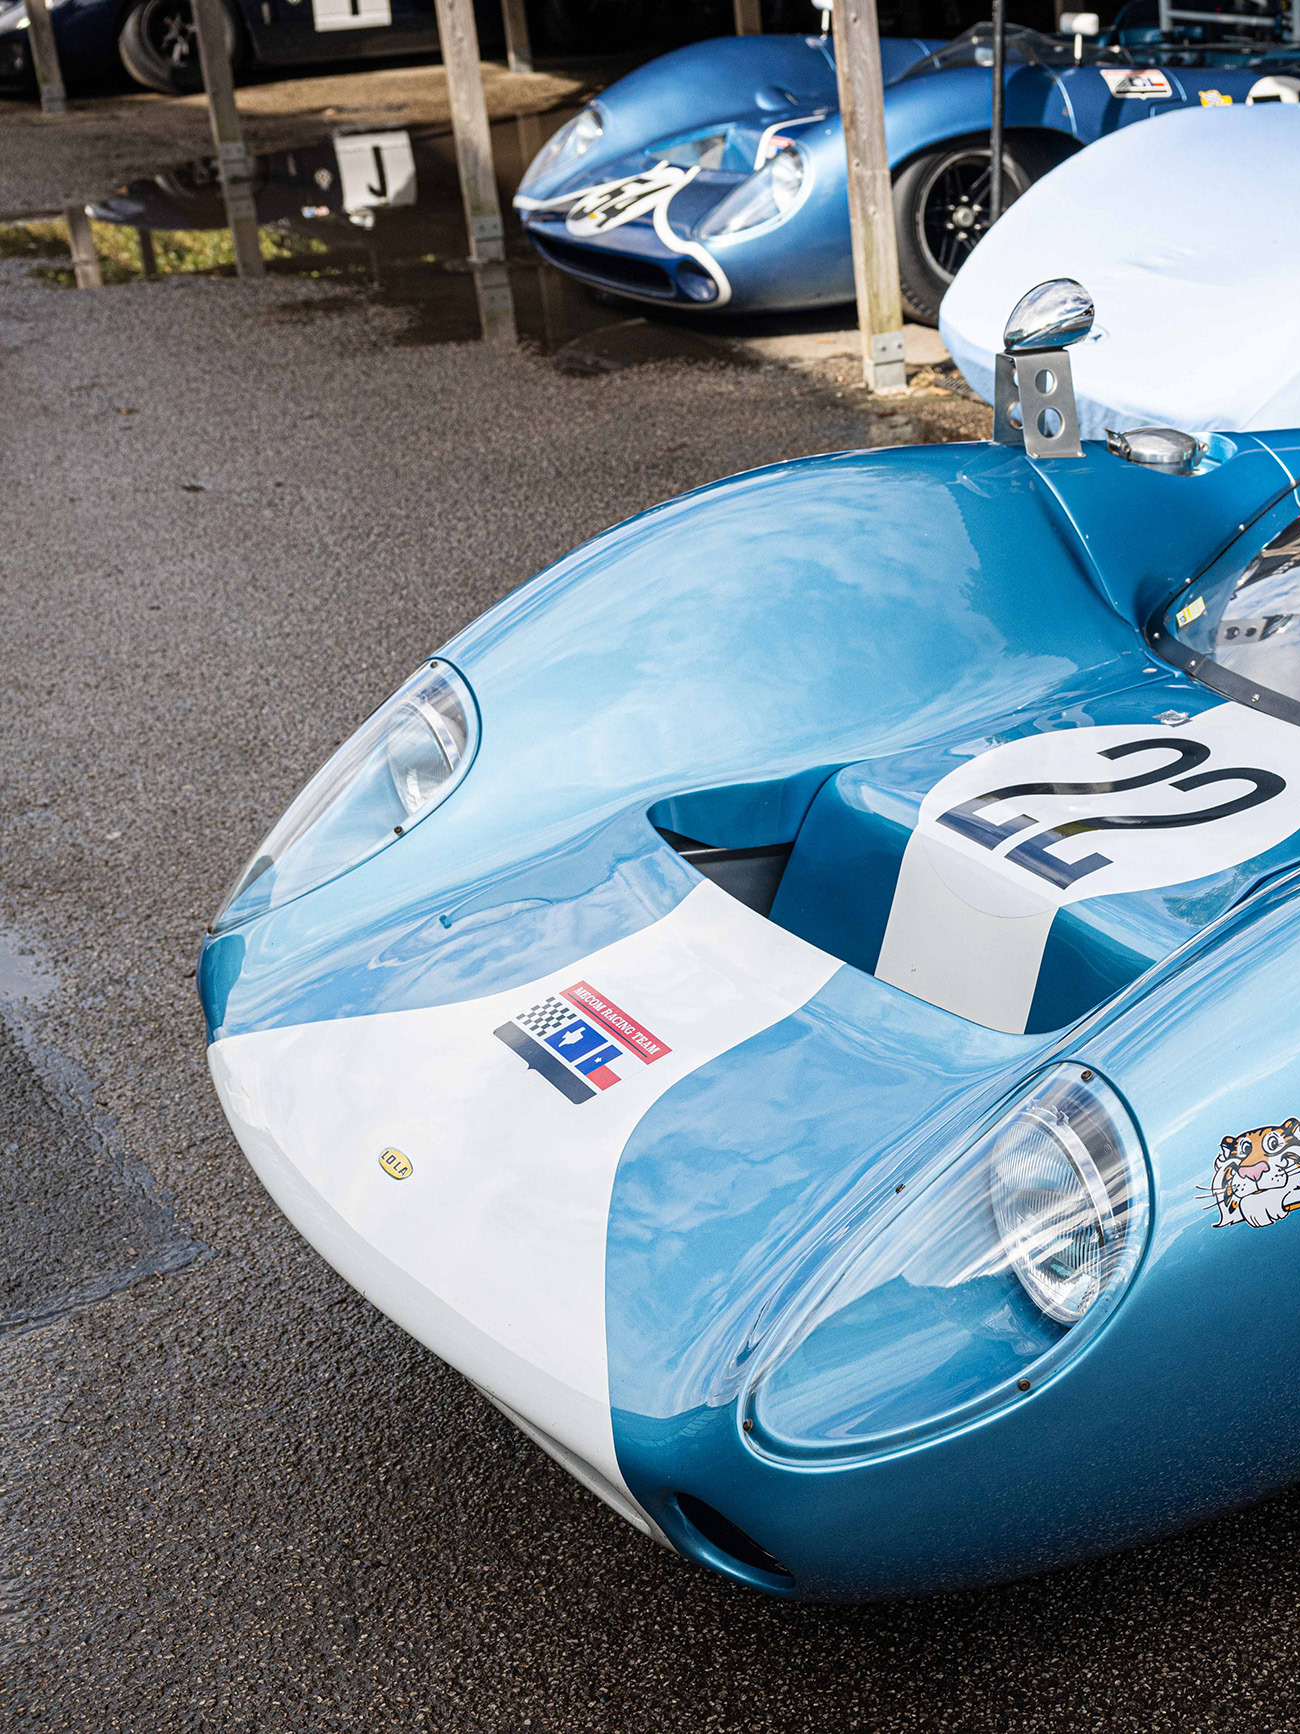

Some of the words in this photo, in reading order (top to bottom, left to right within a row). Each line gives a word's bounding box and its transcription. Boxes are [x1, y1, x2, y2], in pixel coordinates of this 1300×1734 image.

[936, 738, 1287, 890] 22
[573, 987, 602, 1012] MECOM
[600, 1008, 636, 1035] RACING
[631, 1031, 661, 1055] TEAM
[381, 1150, 408, 1176] LOLA
